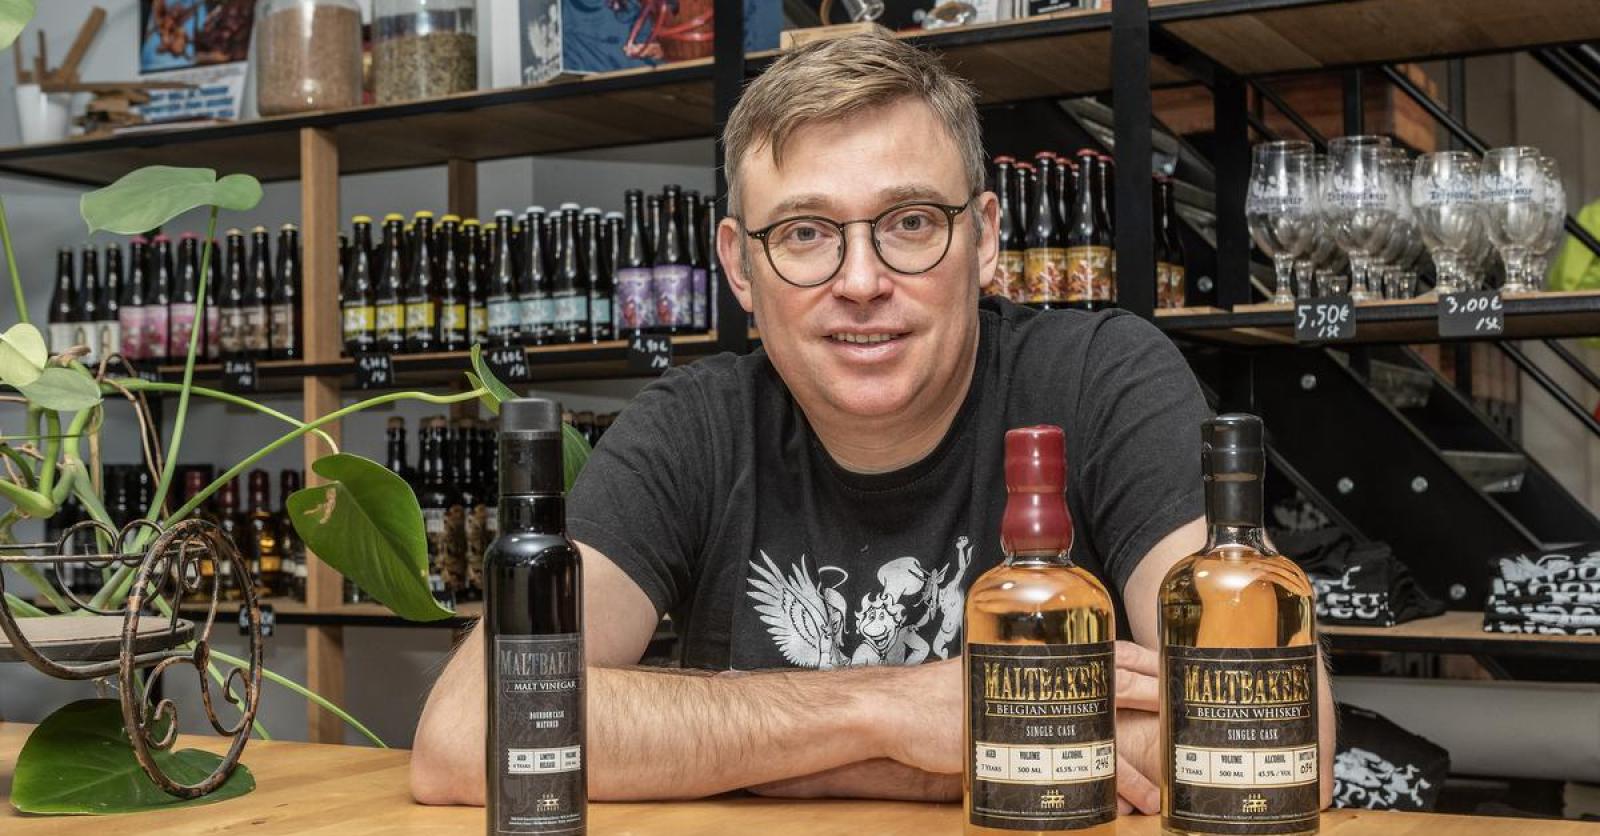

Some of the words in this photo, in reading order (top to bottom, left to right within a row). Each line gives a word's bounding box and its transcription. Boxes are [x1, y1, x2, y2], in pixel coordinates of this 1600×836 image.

[514, 682, 537, 691] MALT
[540, 680, 577, 690] VINEGAR
[996, 704, 1047, 715] BELGIAN
[1050, 703, 1099, 714] WHISKEY
[1197, 707, 1249, 718] BELGIAN
[1252, 707, 1302, 718] WHISKEY
[1026, 724, 1053, 737] SINGLE
[1057, 724, 1076, 736] CASK
[1227, 728, 1256, 741] SINGLE
[1260, 728, 1278, 740] CASK
[1019, 751, 1041, 761] VOLUME
[1062, 750, 1083, 760] ALCOHOL
[1221, 755, 1242, 764] VOLUME
[1264, 754, 1286, 764] ALCOHOL
[1185, 768, 1203, 776] YEARS
